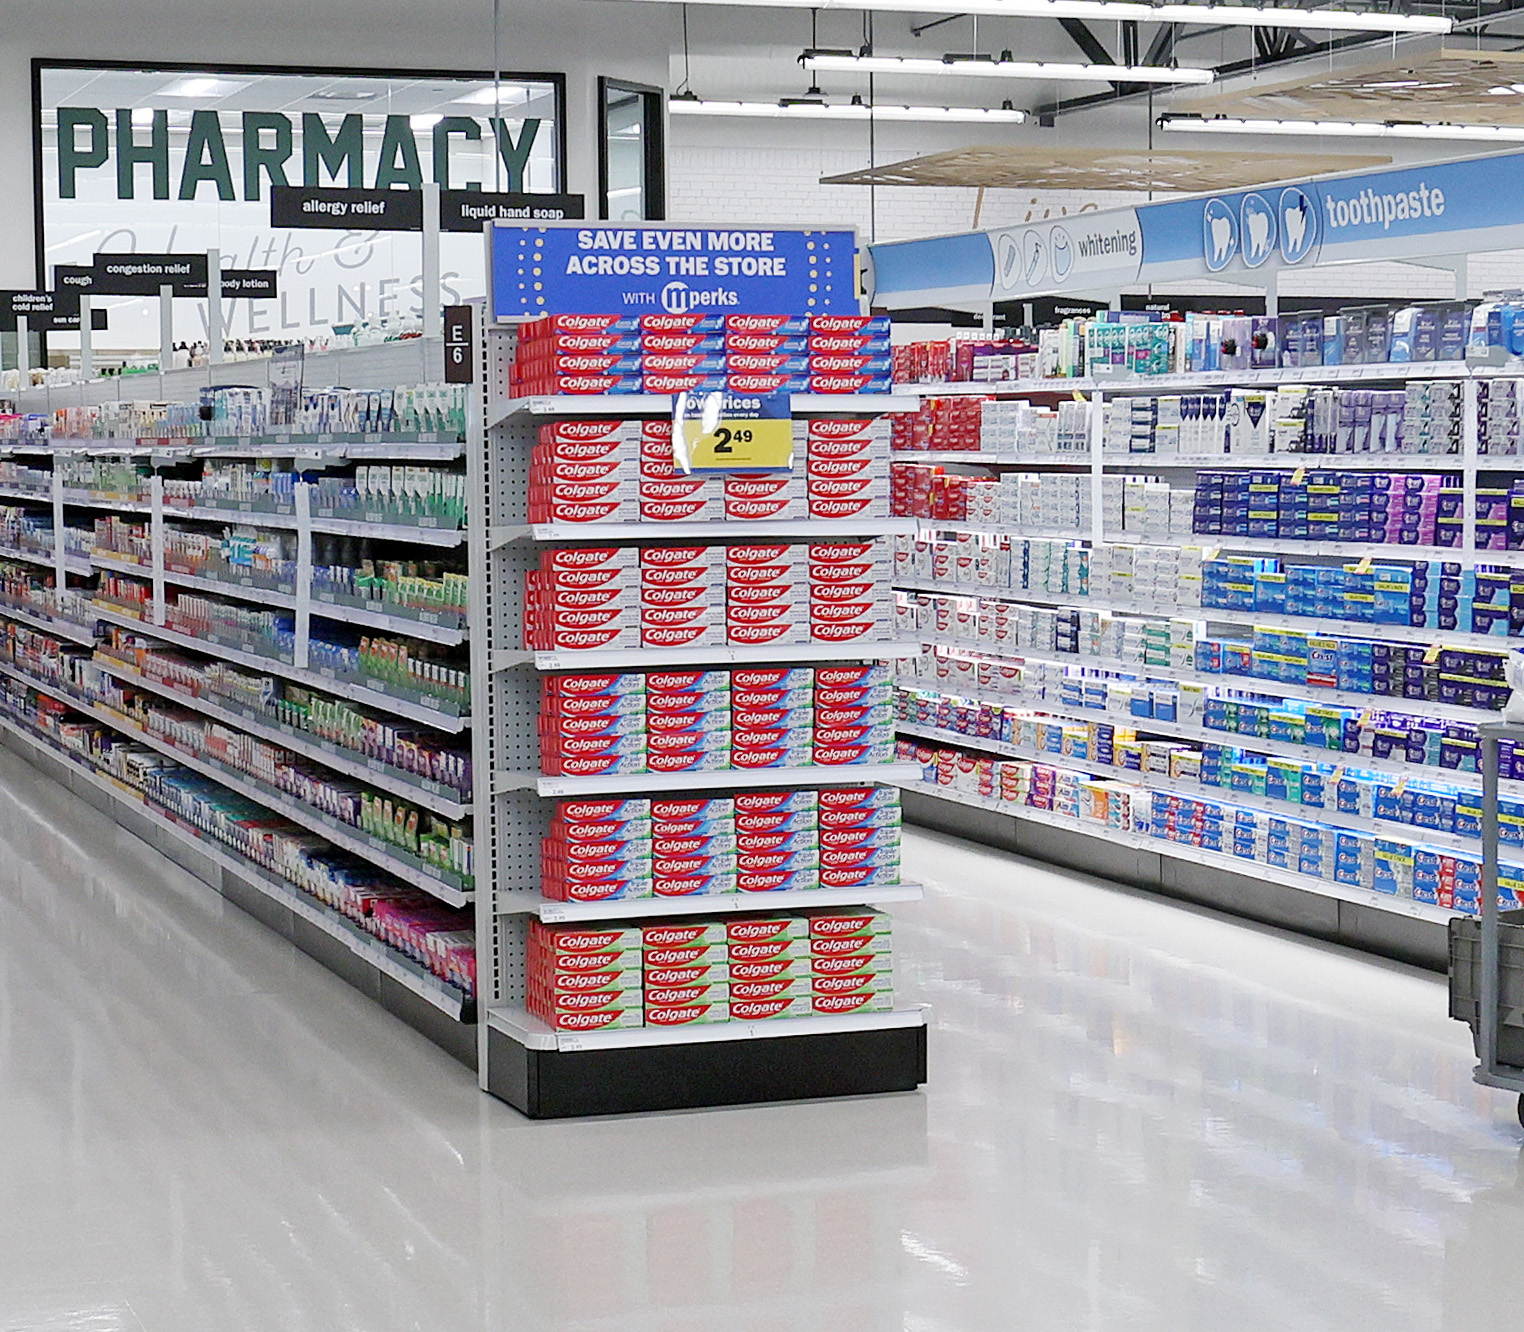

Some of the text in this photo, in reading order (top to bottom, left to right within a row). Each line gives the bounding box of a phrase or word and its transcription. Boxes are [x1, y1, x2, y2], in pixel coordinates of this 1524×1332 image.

[57, 107, 541, 200] PHARMACY
[302, 200, 385, 215] allergy relief
[461, 205, 564, 220] liquid hand soap
[1326, 182, 1446, 230] toothpaste
[578, 230, 774, 252] SAVE EVEN MORE
[1078, 230, 1137, 258] whitening
[106, 263, 191, 275] congestion relief
[566, 255, 786, 277] ACROSS THE STORE
[63, 275, 92, 286] cough
[242, 279, 269, 289] lotion
[12, 294, 52, 303] children's
[196, 271, 462, 339] WELLNESS
[623, 292, 655, 304] WITH
[12, 302, 53, 311] cold relief
[557, 315, 612, 330] Colgate
[643, 315, 696, 329] Colgate
[728, 316, 780, 329] Colgate
[812, 317, 863, 331] Colgate
[453, 325, 463, 342] E
[558, 336, 612, 350] Colgate
[644, 335, 696, 350] Colgate
[729, 336, 780, 350] Colgate
[812, 337, 863, 351] Colgate
[453, 347, 463, 364] 6
[558, 376, 611, 391] Colgate
[646, 375, 698, 390] Colgate
[729, 375, 780, 389] Colgate
[811, 377, 862, 391] Colgate
[722, 396, 761, 410] rices
[555, 422, 611, 437] Colgate
[643, 482, 694, 496] Colgate
[812, 501, 863, 516] Colgate
[555, 549, 609, 564] Colgate
[729, 546, 779, 560] Colgate
[810, 545, 862, 559] Colgate
[735, 672, 781, 684] Colgate
[820, 669, 863, 682] Colgate
[563, 677, 611, 690] Colgate
[737, 795, 784, 808] Colgate
[821, 791, 866, 803] Colgate
[566, 803, 614, 816] Colgate
[653, 803, 700, 815] Colgate
[730, 924, 781, 937] Colgate
[814, 919, 864, 931] Colgate
[558, 934, 613, 948] Colgate
